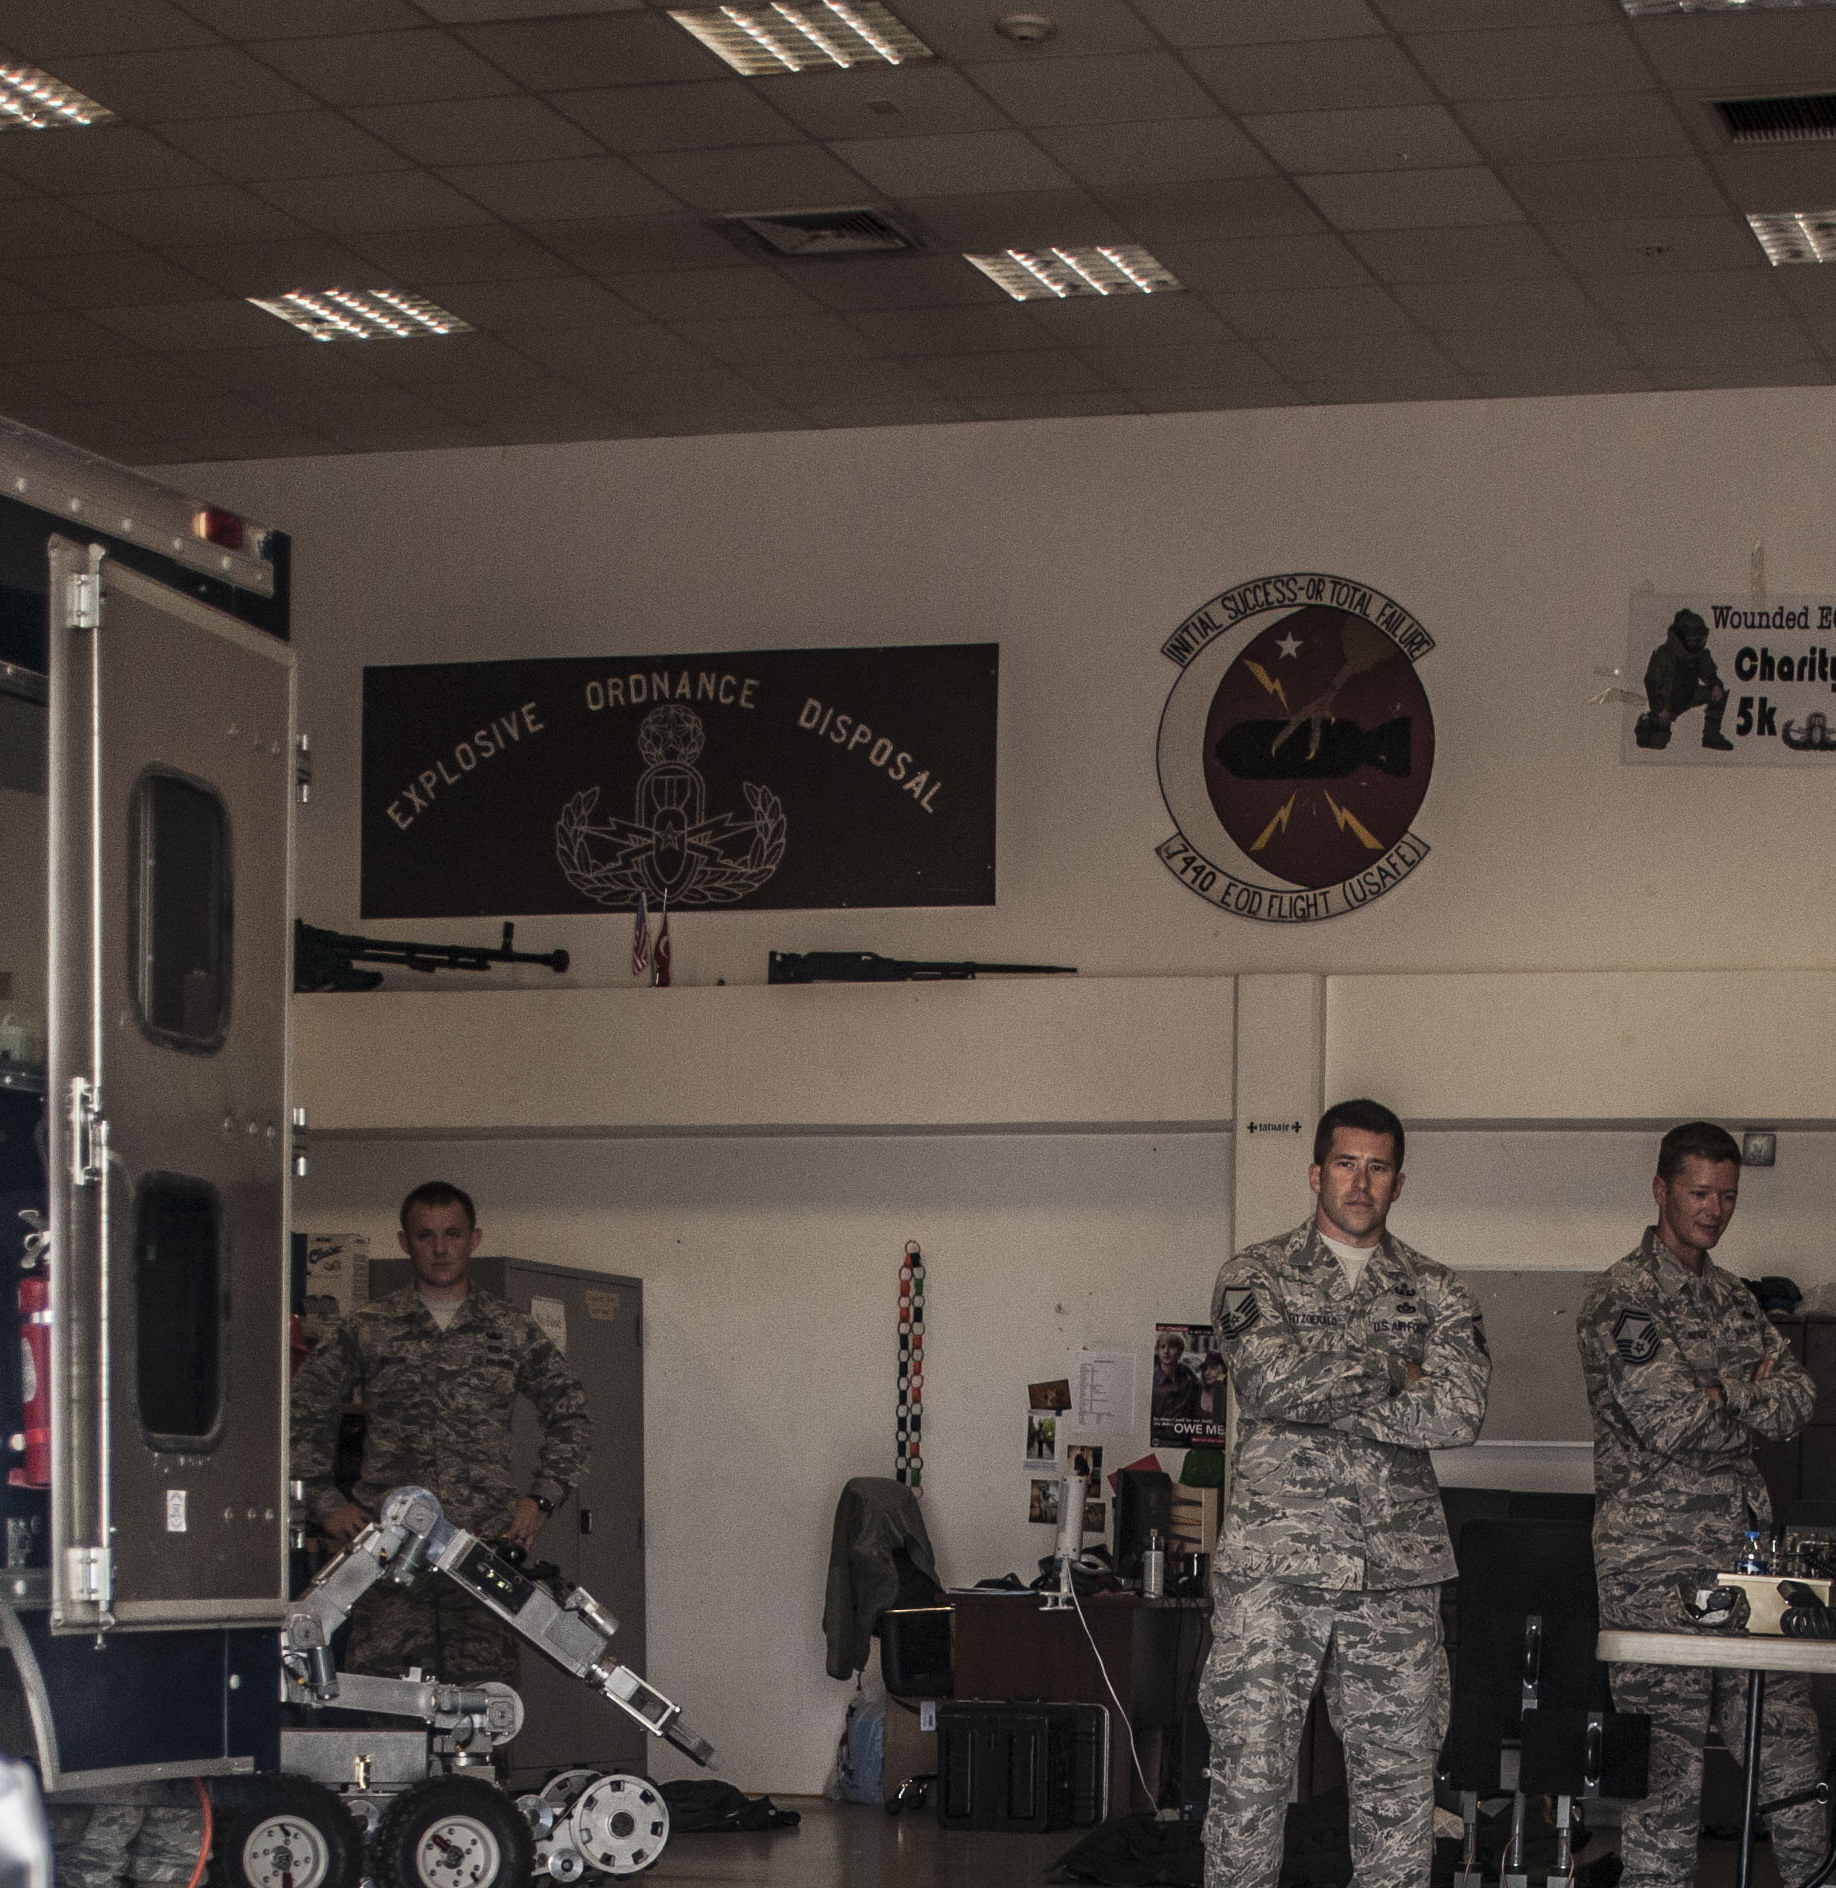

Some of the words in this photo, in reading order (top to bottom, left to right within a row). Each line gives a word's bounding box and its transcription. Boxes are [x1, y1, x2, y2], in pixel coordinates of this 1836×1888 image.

[1166, 611, 1223, 664] INITIAL
[1330, 580, 1371, 618] TOTAL
[1376, 602, 1431, 657] FAILURE
[1711, 605, 1810, 631] Wounded
[1735, 695, 1778, 737] 5k
[384, 701, 546, 832] EXPLOSIVE
[585, 671, 760, 713] ORDNANCE
[796, 697, 944, 814] DISPOSAL
[1165, 842, 1215, 893] 7440
[1219, 882, 1262, 916] EOD
[1267, 890, 1331, 920] FLIGHT
[1342, 839, 1422, 911] (USAFE)
[1173, 1423, 1203, 1435] OWE
[1205, 1424, 1225, 1436] ME
